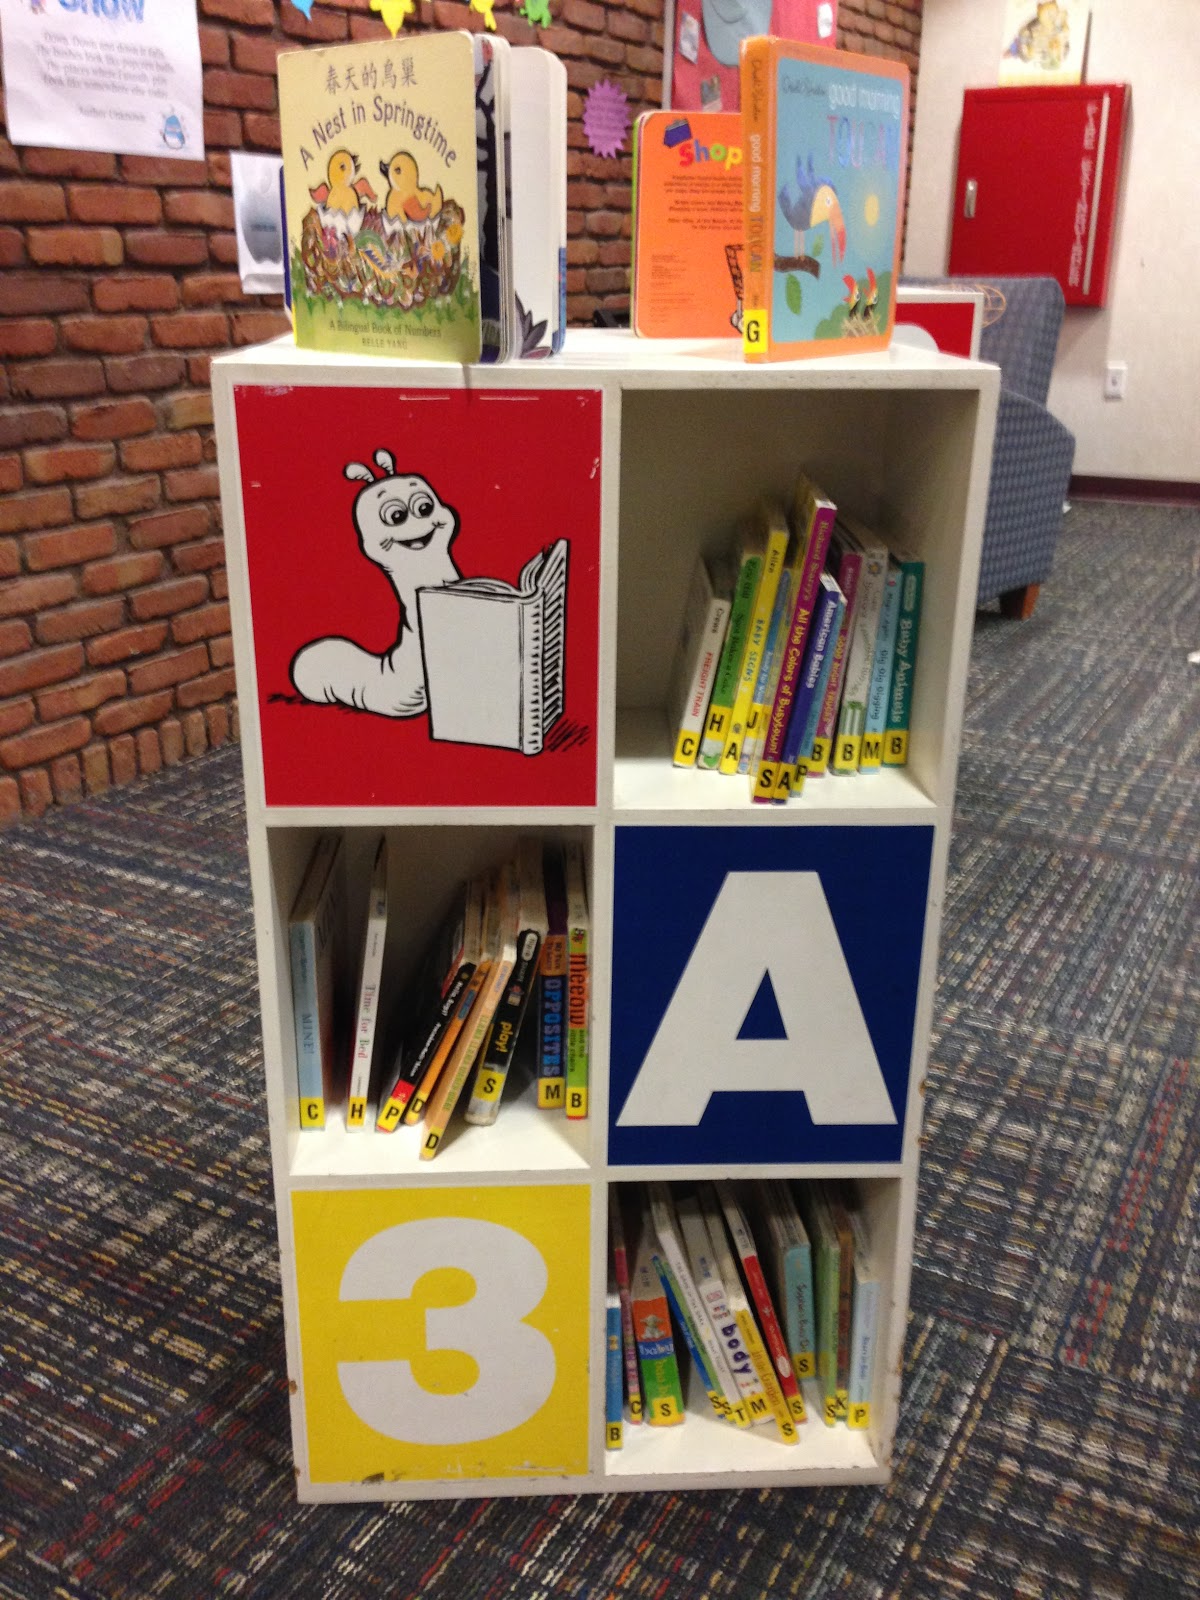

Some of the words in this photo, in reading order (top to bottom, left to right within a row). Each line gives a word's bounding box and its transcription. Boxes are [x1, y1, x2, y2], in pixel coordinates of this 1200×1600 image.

[325, 57, 417, 95] 春天的鳥巢
[829, 83, 857, 112] good
[300, 149, 314, 171] A
[311, 115, 347, 151] Nest
[352, 100, 366, 125] in
[372, 95, 457, 168] Springtime
[827, 114, 900, 170] TOUAN
[678, 138, 743, 171] shop
[749, 134, 763, 163] good
[748, 166, 763, 213] morning
[371, 322, 393, 335] Book
[746, 320, 761, 343] G
[813, 521, 830, 560] Richard
[803, 562, 819, 601] Scarry's
[712, 608, 724, 633] Crews
[797, 607, 810, 625] All
[753, 619, 764, 645] BABY
[791, 625, 805, 645] the
[816, 600, 838, 652] American
[835, 636, 843, 658] GOOD
[896, 619, 913, 657] Baby
[783, 647, 800, 682] Colors
[878, 649, 887, 664] Dig
[701, 652, 713, 688] FREIGHT
[743, 651, 756, 682] SIGNS
[805, 655, 823, 689] Babies
[876, 668, 885, 683] Dig
[782, 684, 792, 696] of
[891, 660, 913, 722] Animals
[692, 691, 703, 717] TRAIN
[872, 685, 883, 719] Digging
[710, 713, 723, 732] H
[746, 710, 757, 729] J
[768, 698, 790, 754] Busytown!
[682, 738, 693, 756] C
[726, 742, 738, 761] A
[811, 742, 824, 762] B
[842, 744, 854, 762] B
[864, 741, 879, 759] M
[891, 737, 903, 755] B
[760, 769, 773, 788] S
[777, 771, 791, 790] A
[569, 953, 586, 1024] meeow
[363, 985, 375, 1012] Time
[616, 870, 898, 1128] A
[301, 1013, 314, 1053] MINE!
[360, 1018, 371, 1032] for
[543, 979, 561, 1075] OPPOSITES
[496, 1021, 514, 1053] play!
[358, 1039, 369, 1058] Bed
[483, 1078, 496, 1093] S
[546, 1085, 561, 1100] M
[411, 1099, 425, 1114] D
[571, 1093, 582, 1108] B
[307, 1104, 318, 1119] C
[351, 1103, 363, 1118] H
[385, 1106, 399, 1120] P
[426, 1133, 439, 1149] D
[337, 1217, 557, 1447] 3
[721, 1323, 752, 1375] body
[800, 1359, 809, 1372] S
[632, 1401, 642, 1414] C
[660, 1404, 672, 1417] S
[711, 1396, 721, 1409] S
[723, 1402, 732, 1415] S
[751, 1399, 768, 1414] M
[792, 1401, 804, 1414] S
[826, 1404, 836, 1418] S
[735, 1408, 746, 1422] T
[854, 1408, 866, 1422] P
[610, 1427, 620, 1441] B
[783, 1422, 794, 1436] S
